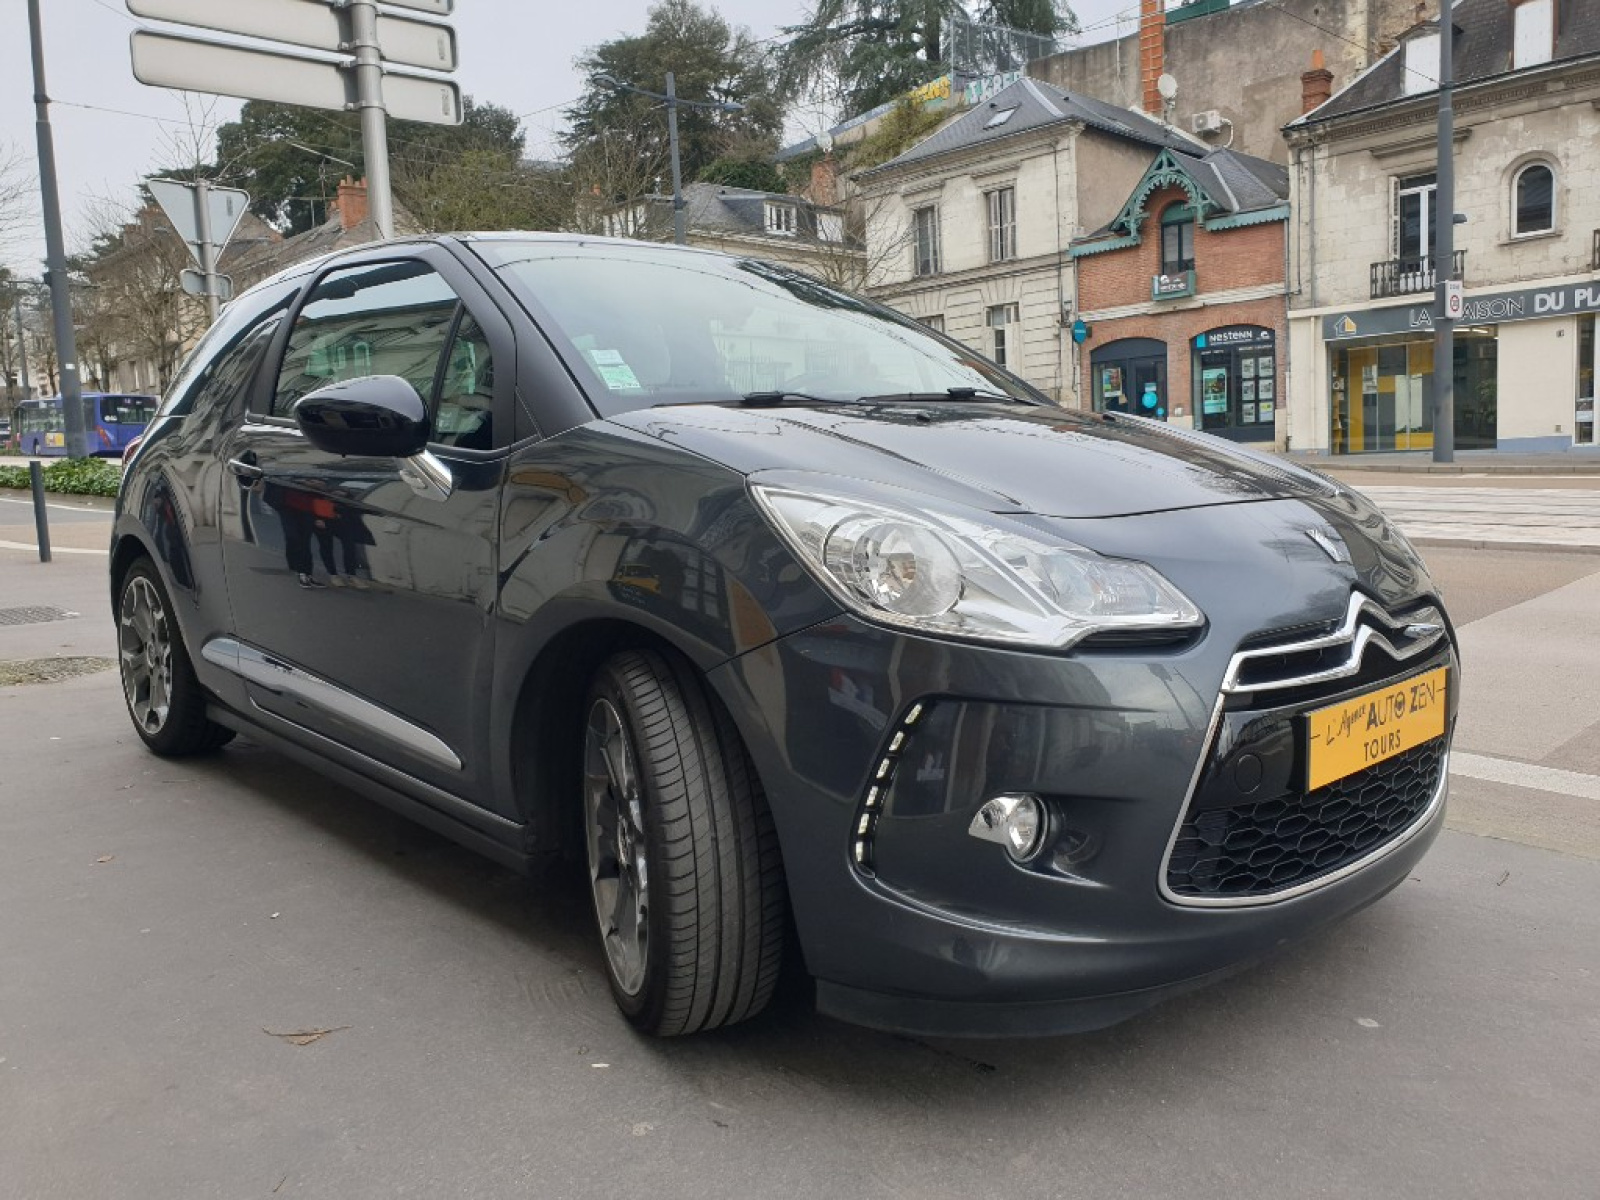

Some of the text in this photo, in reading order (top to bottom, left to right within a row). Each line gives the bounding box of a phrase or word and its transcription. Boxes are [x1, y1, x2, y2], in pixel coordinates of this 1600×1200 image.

[1409, 286, 1600, 327] LA AISON DU PL
[1366, 690, 1406, 731] AUTO
[1410, 679, 1435, 713] ZEN
[1364, 729, 1401, 761] TOURS
